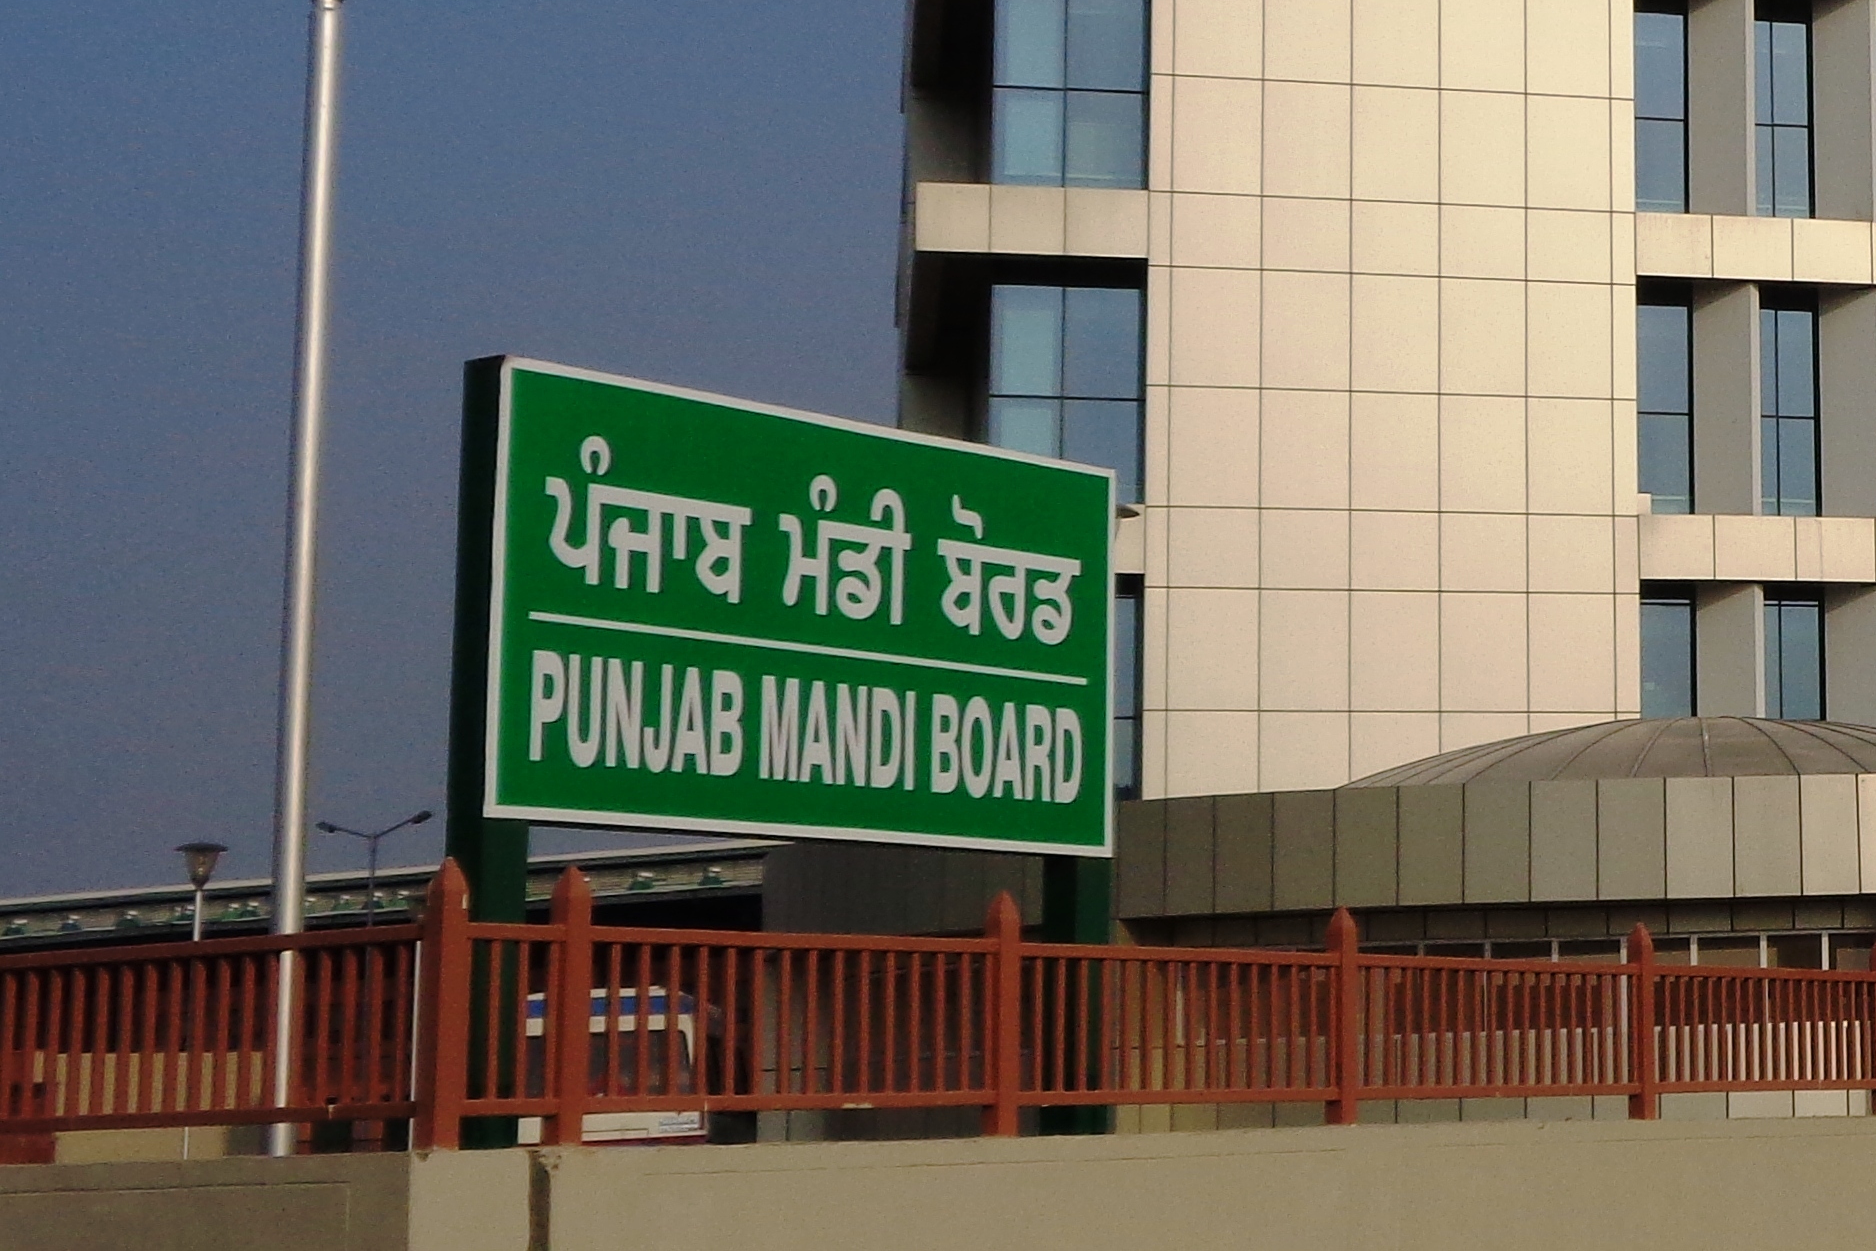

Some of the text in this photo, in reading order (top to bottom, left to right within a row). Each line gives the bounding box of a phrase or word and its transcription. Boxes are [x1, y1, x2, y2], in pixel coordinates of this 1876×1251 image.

[545, 435, 1082, 645] ਪੰਜਾਬ ਮੰਡੀ ਬੋਰਡ
[528, 650, 1083, 804] PUNJAB MANDI BOARD
